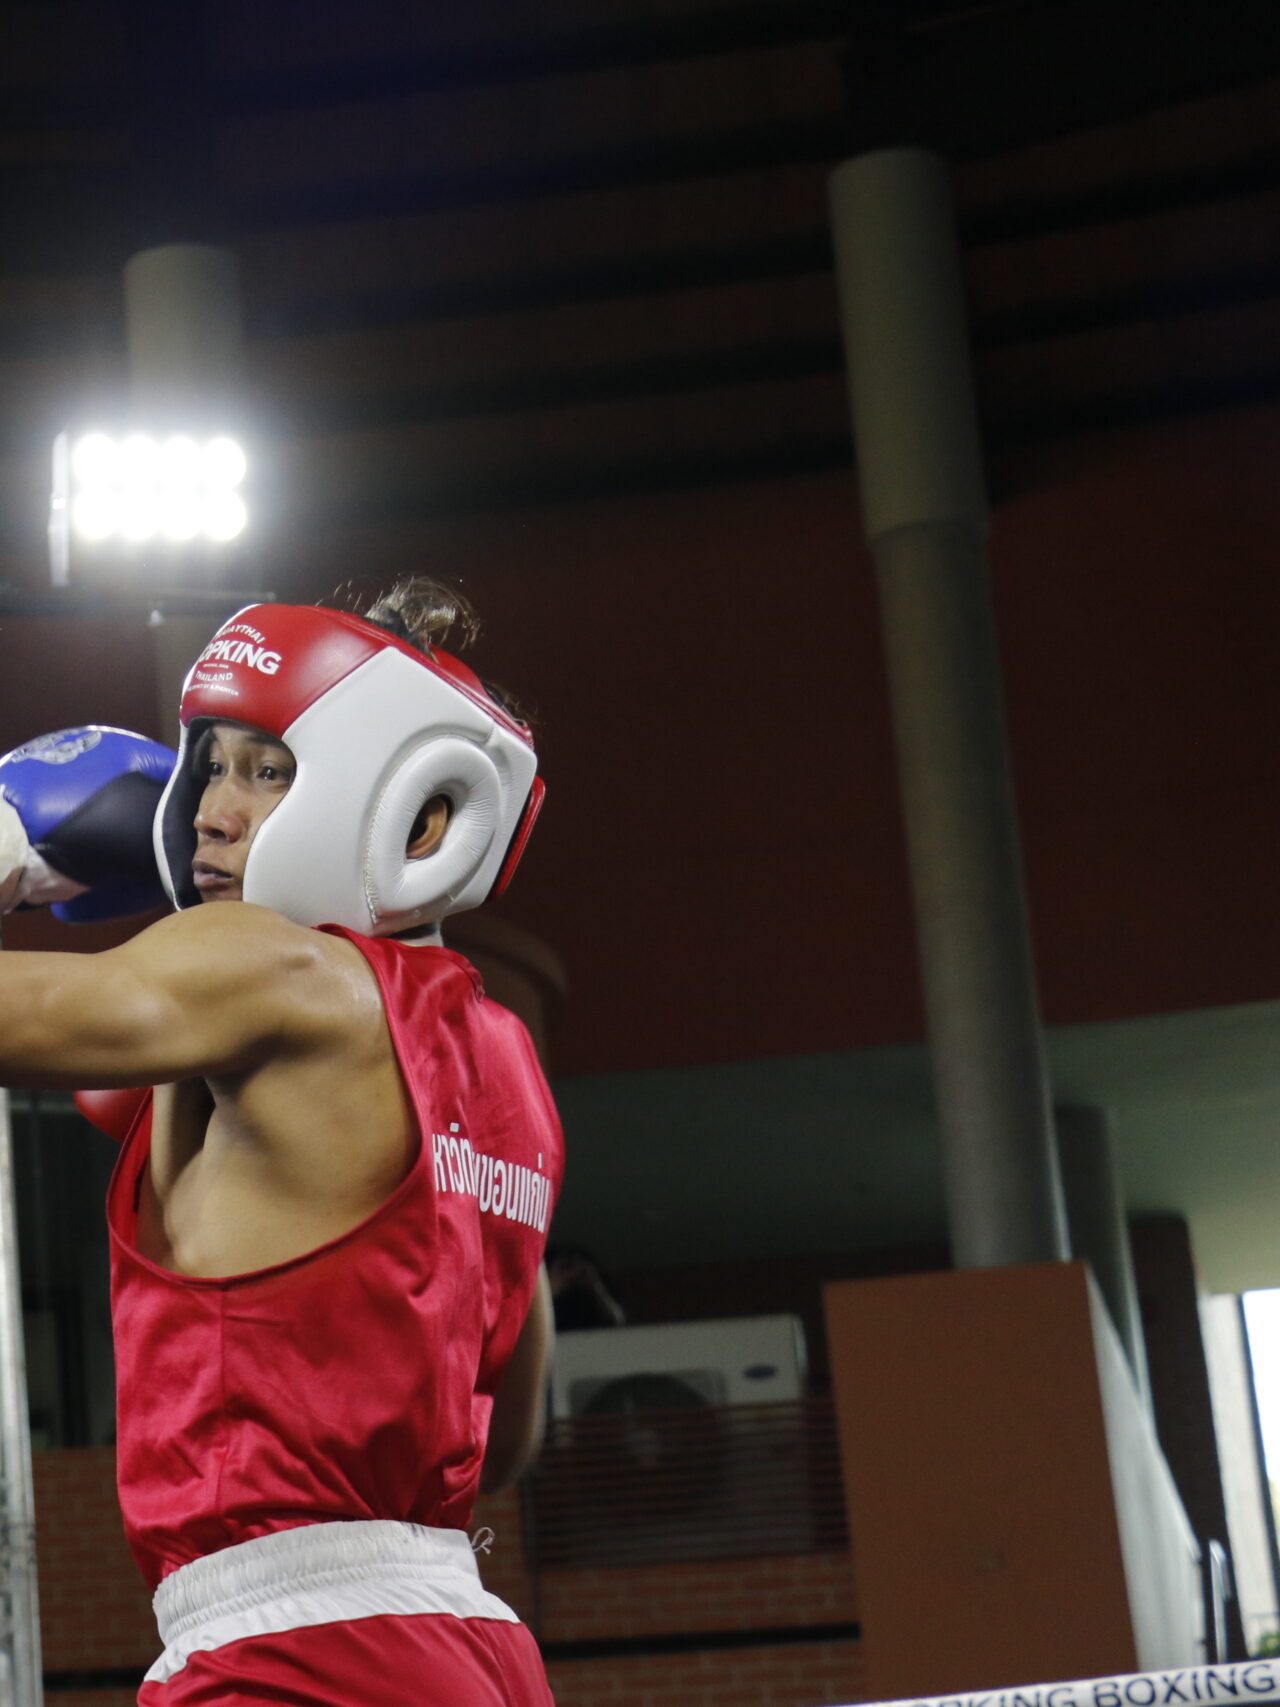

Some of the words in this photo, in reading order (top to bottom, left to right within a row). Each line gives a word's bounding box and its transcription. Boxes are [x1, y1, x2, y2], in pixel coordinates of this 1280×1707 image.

[198, 640, 282, 675] OPKING
[196, 670, 234, 681] THAILAND
[1093, 1663, 1276, 1707] BOXING
